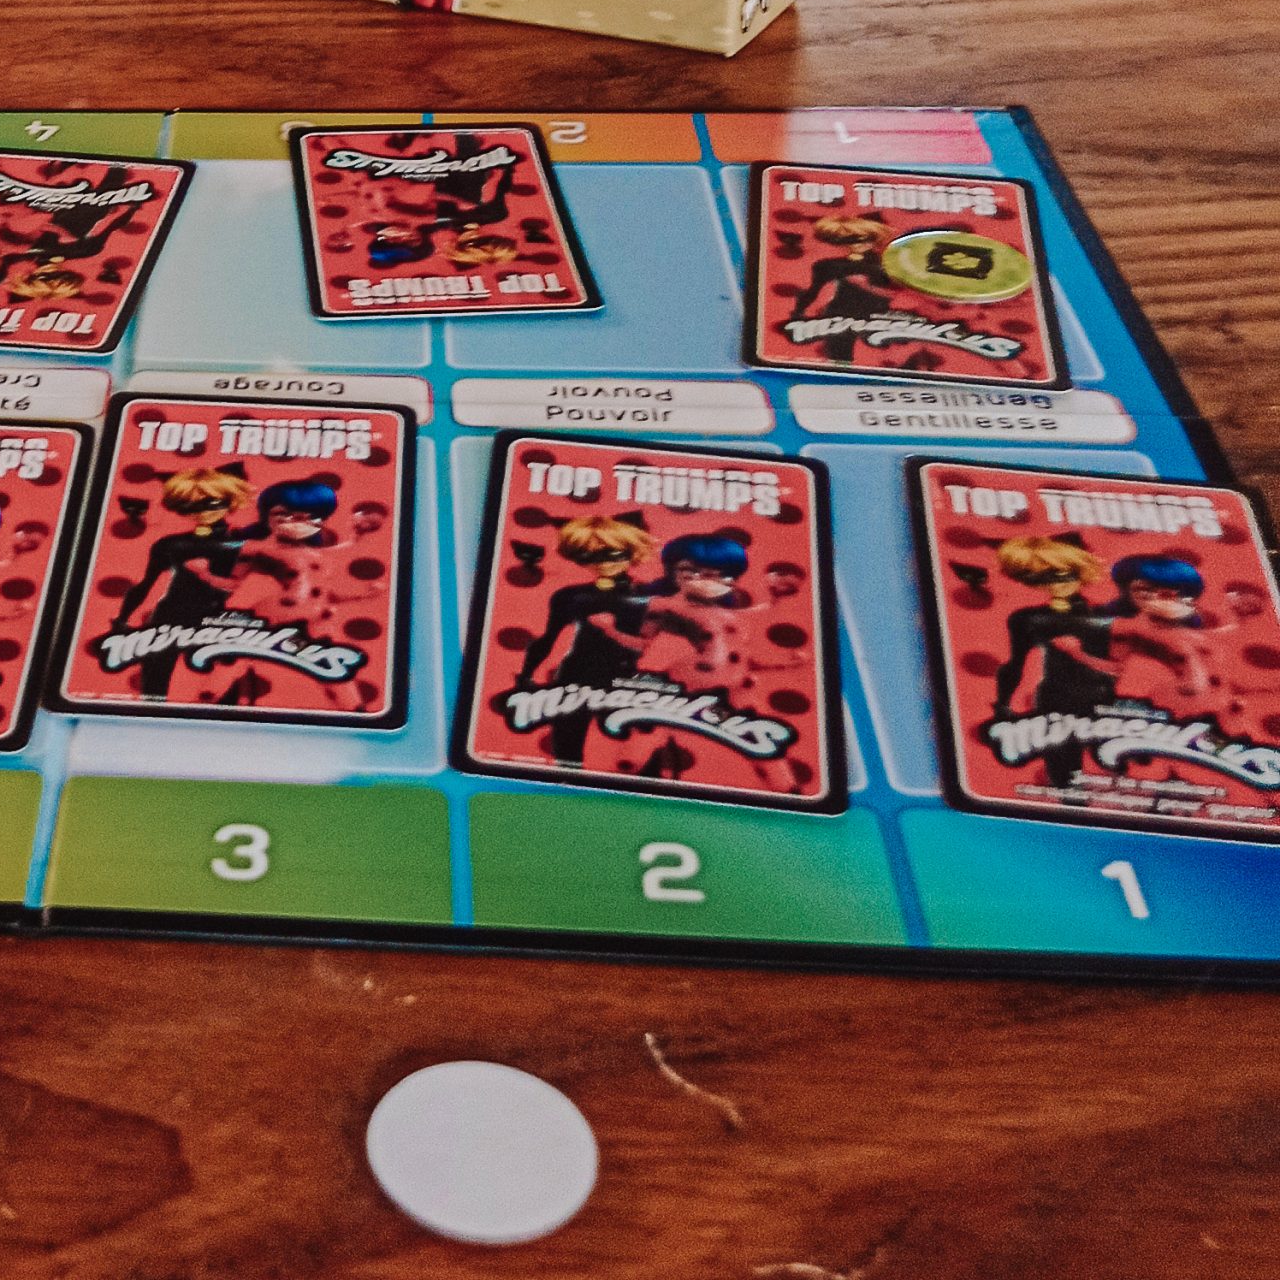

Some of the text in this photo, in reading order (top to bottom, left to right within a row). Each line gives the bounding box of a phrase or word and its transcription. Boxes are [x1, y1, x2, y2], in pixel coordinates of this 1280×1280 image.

[24, 120, 61, 142] 4
[548, 120, 587, 144] 2
[780, 180, 998, 217] TOP TRUMPS
[347, 272, 566, 306] TOP TRUMPS
[30, 311, 97, 334] TOP
[214, 376, 346, 396] Courage
[546, 384, 675, 402] Pouvoir
[857, 389, 1054, 410] Gentillesse
[545, 404, 674, 424] Pouvoir
[858, 410, 1059, 431] Gentillesse
[138, 419, 373, 461] TOP TRUMPS
[527, 462, 782, 517] TOP TRUMPS
[944, 484, 1223, 537] TOP TRUMPS
[211, 823, 270, 881] 3
[638, 841, 706, 902] 2
[1101, 859, 1150, 920] 1
